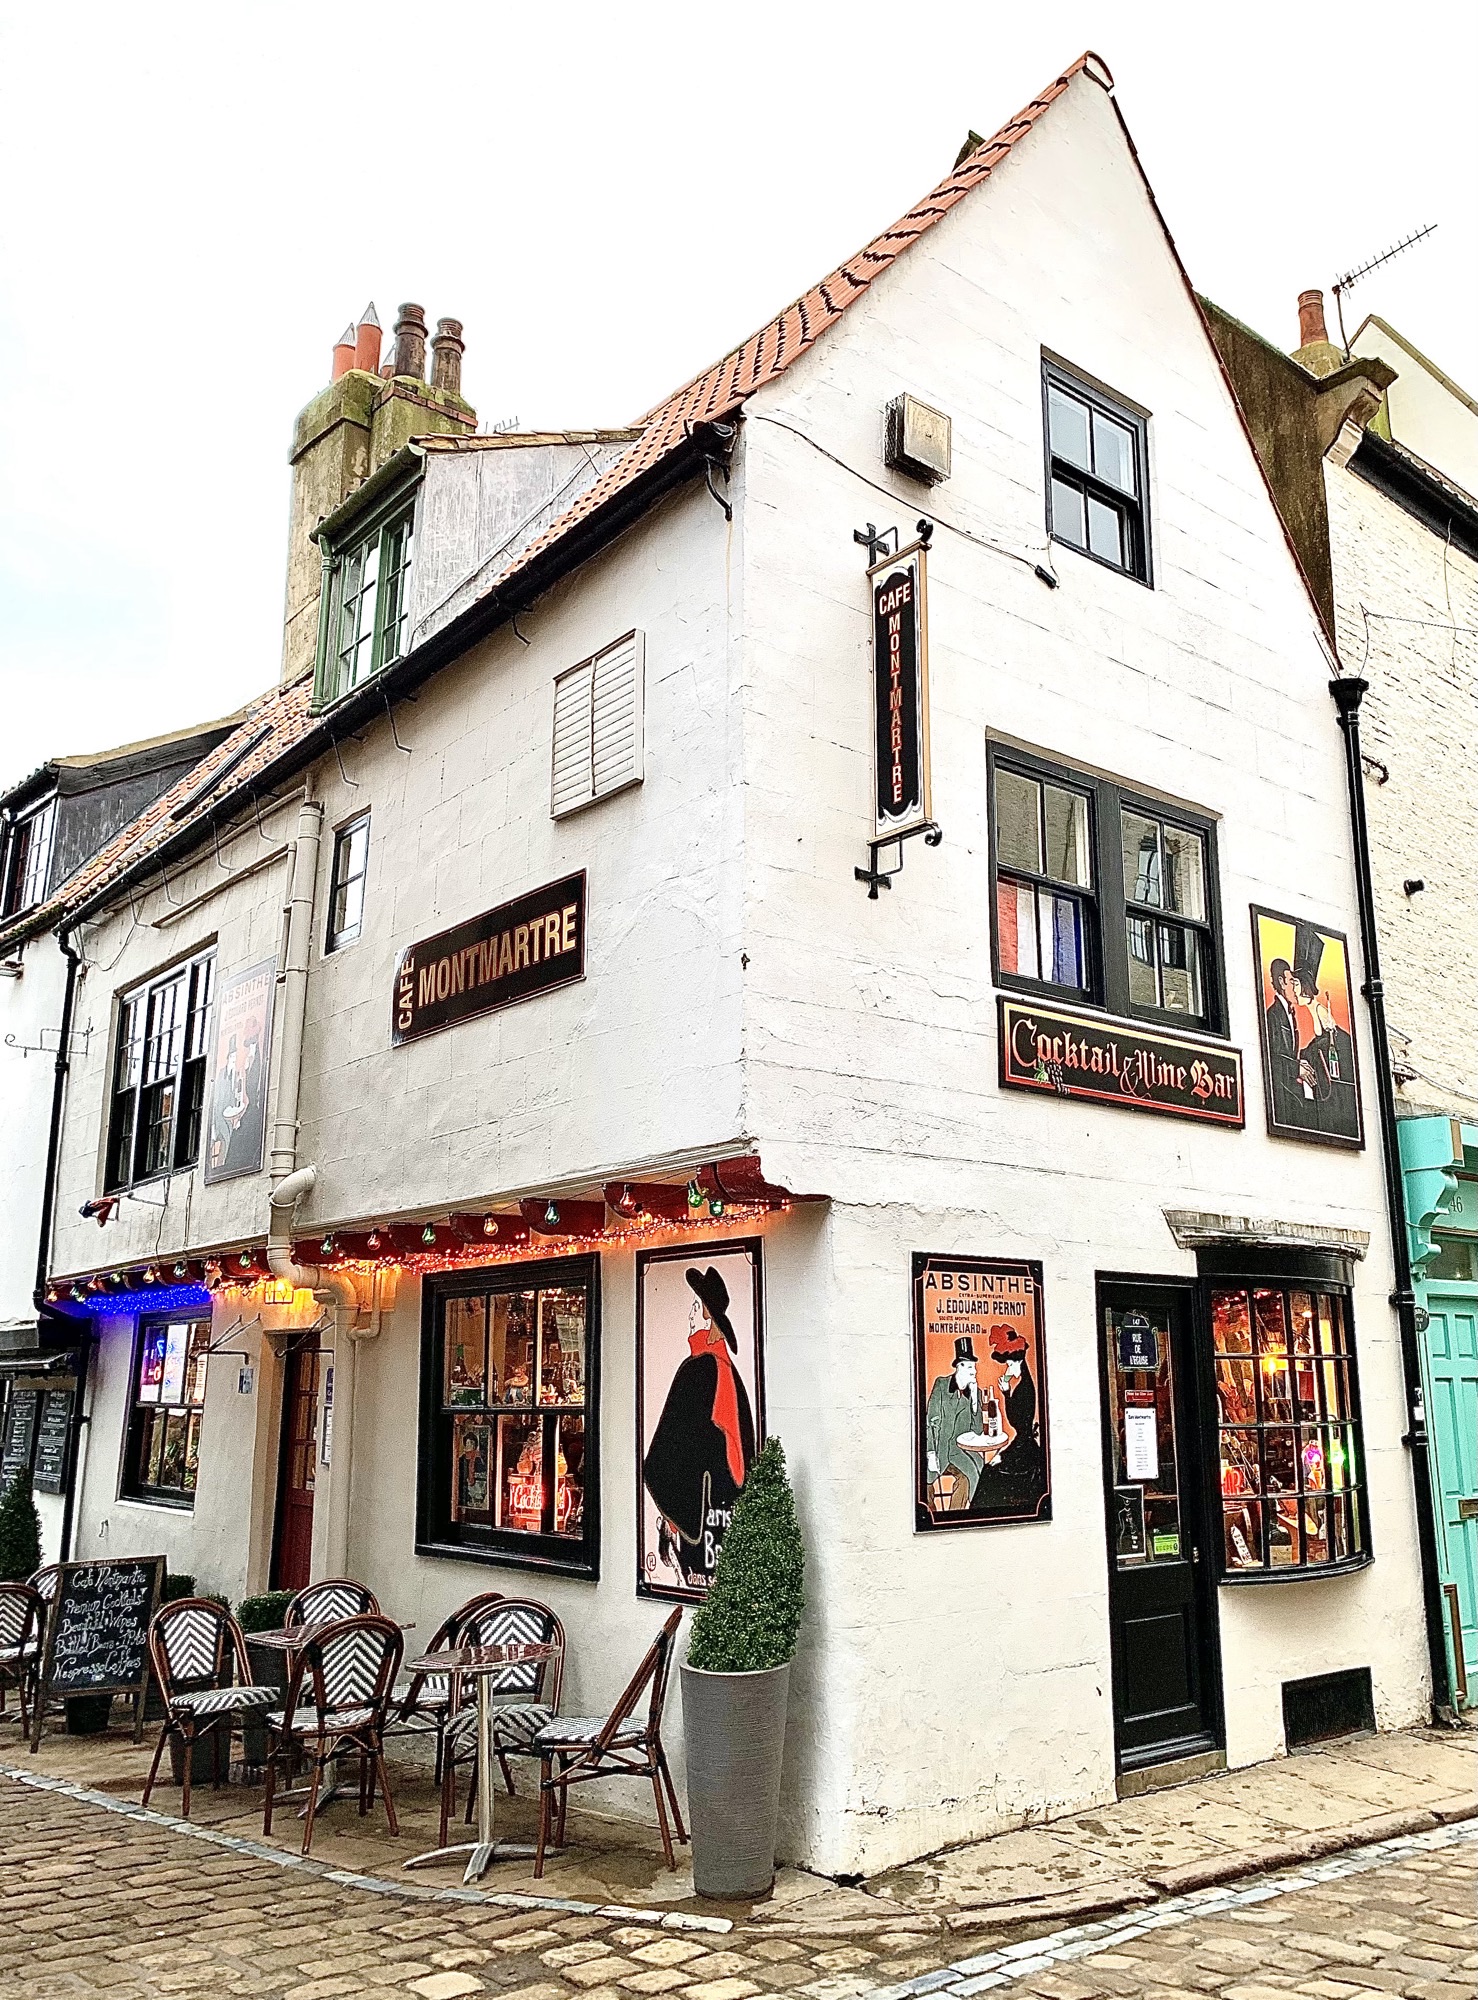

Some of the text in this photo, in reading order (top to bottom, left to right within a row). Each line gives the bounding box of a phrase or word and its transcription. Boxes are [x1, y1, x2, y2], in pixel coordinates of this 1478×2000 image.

[879, 582, 911, 616] CAFE
[889, 613, 903, 804] MONTMARTRE
[418, 903, 578, 1009] MONTMARTRE
[222, 973, 270, 1004] ABSINTHE
[398, 957, 415, 1030] CAFE
[1012, 1018, 1235, 1102] Cocktail & Wine Bar
[925, 1272, 1034, 1294] ABSINTHE
[936, 1299, 945, 1314] J.
[992, 1301, 1026, 1316] PERNOT
[1131, 1333, 1143, 1343] RUE
[1134, 1344, 1142, 1354] DE
[706, 1501, 732, 1528] aris
[687, 1566, 706, 1586] dans
[52, 1657, 105, 1683] Nespresso
